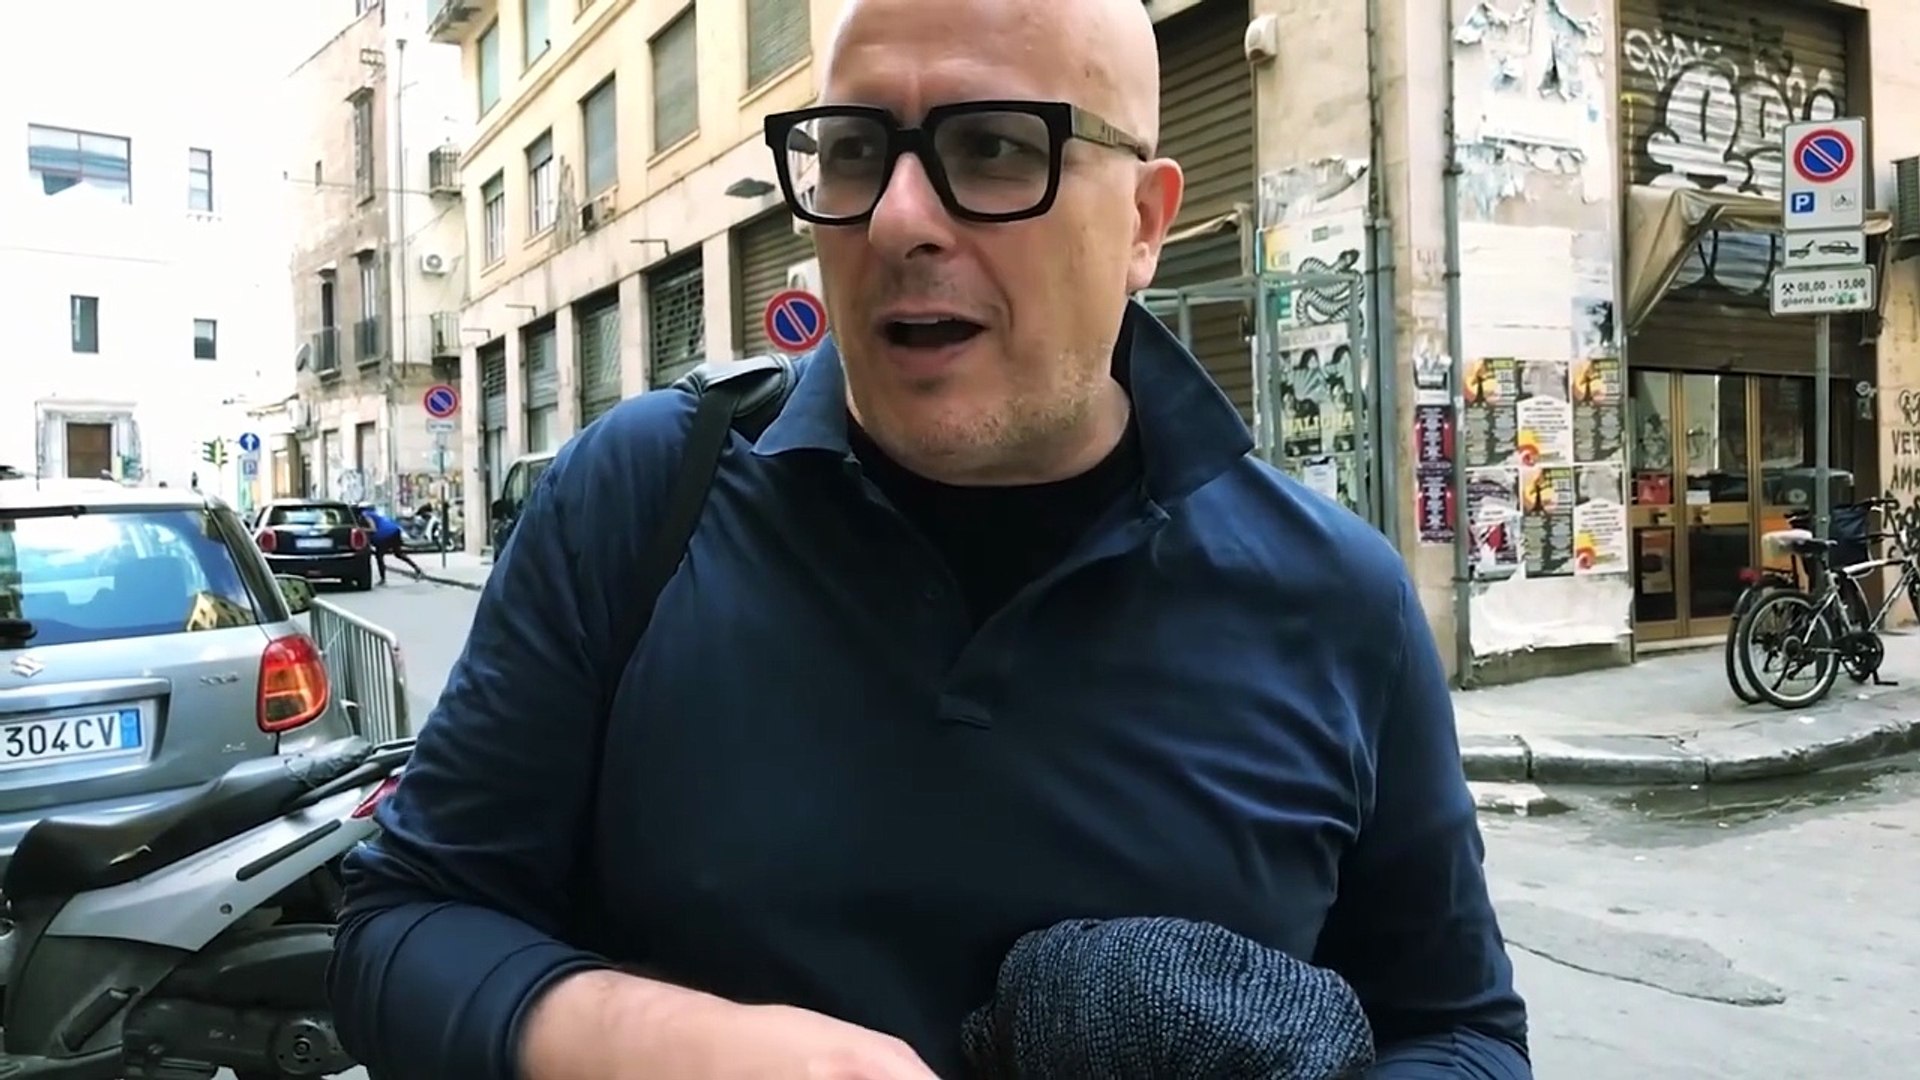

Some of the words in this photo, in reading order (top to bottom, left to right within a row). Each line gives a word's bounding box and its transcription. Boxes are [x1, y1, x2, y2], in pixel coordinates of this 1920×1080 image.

[1795, 196, 1809, 210] P
[1781, 296, 1814, 308] giorni
[4, 714, 115, 757] 304CV
